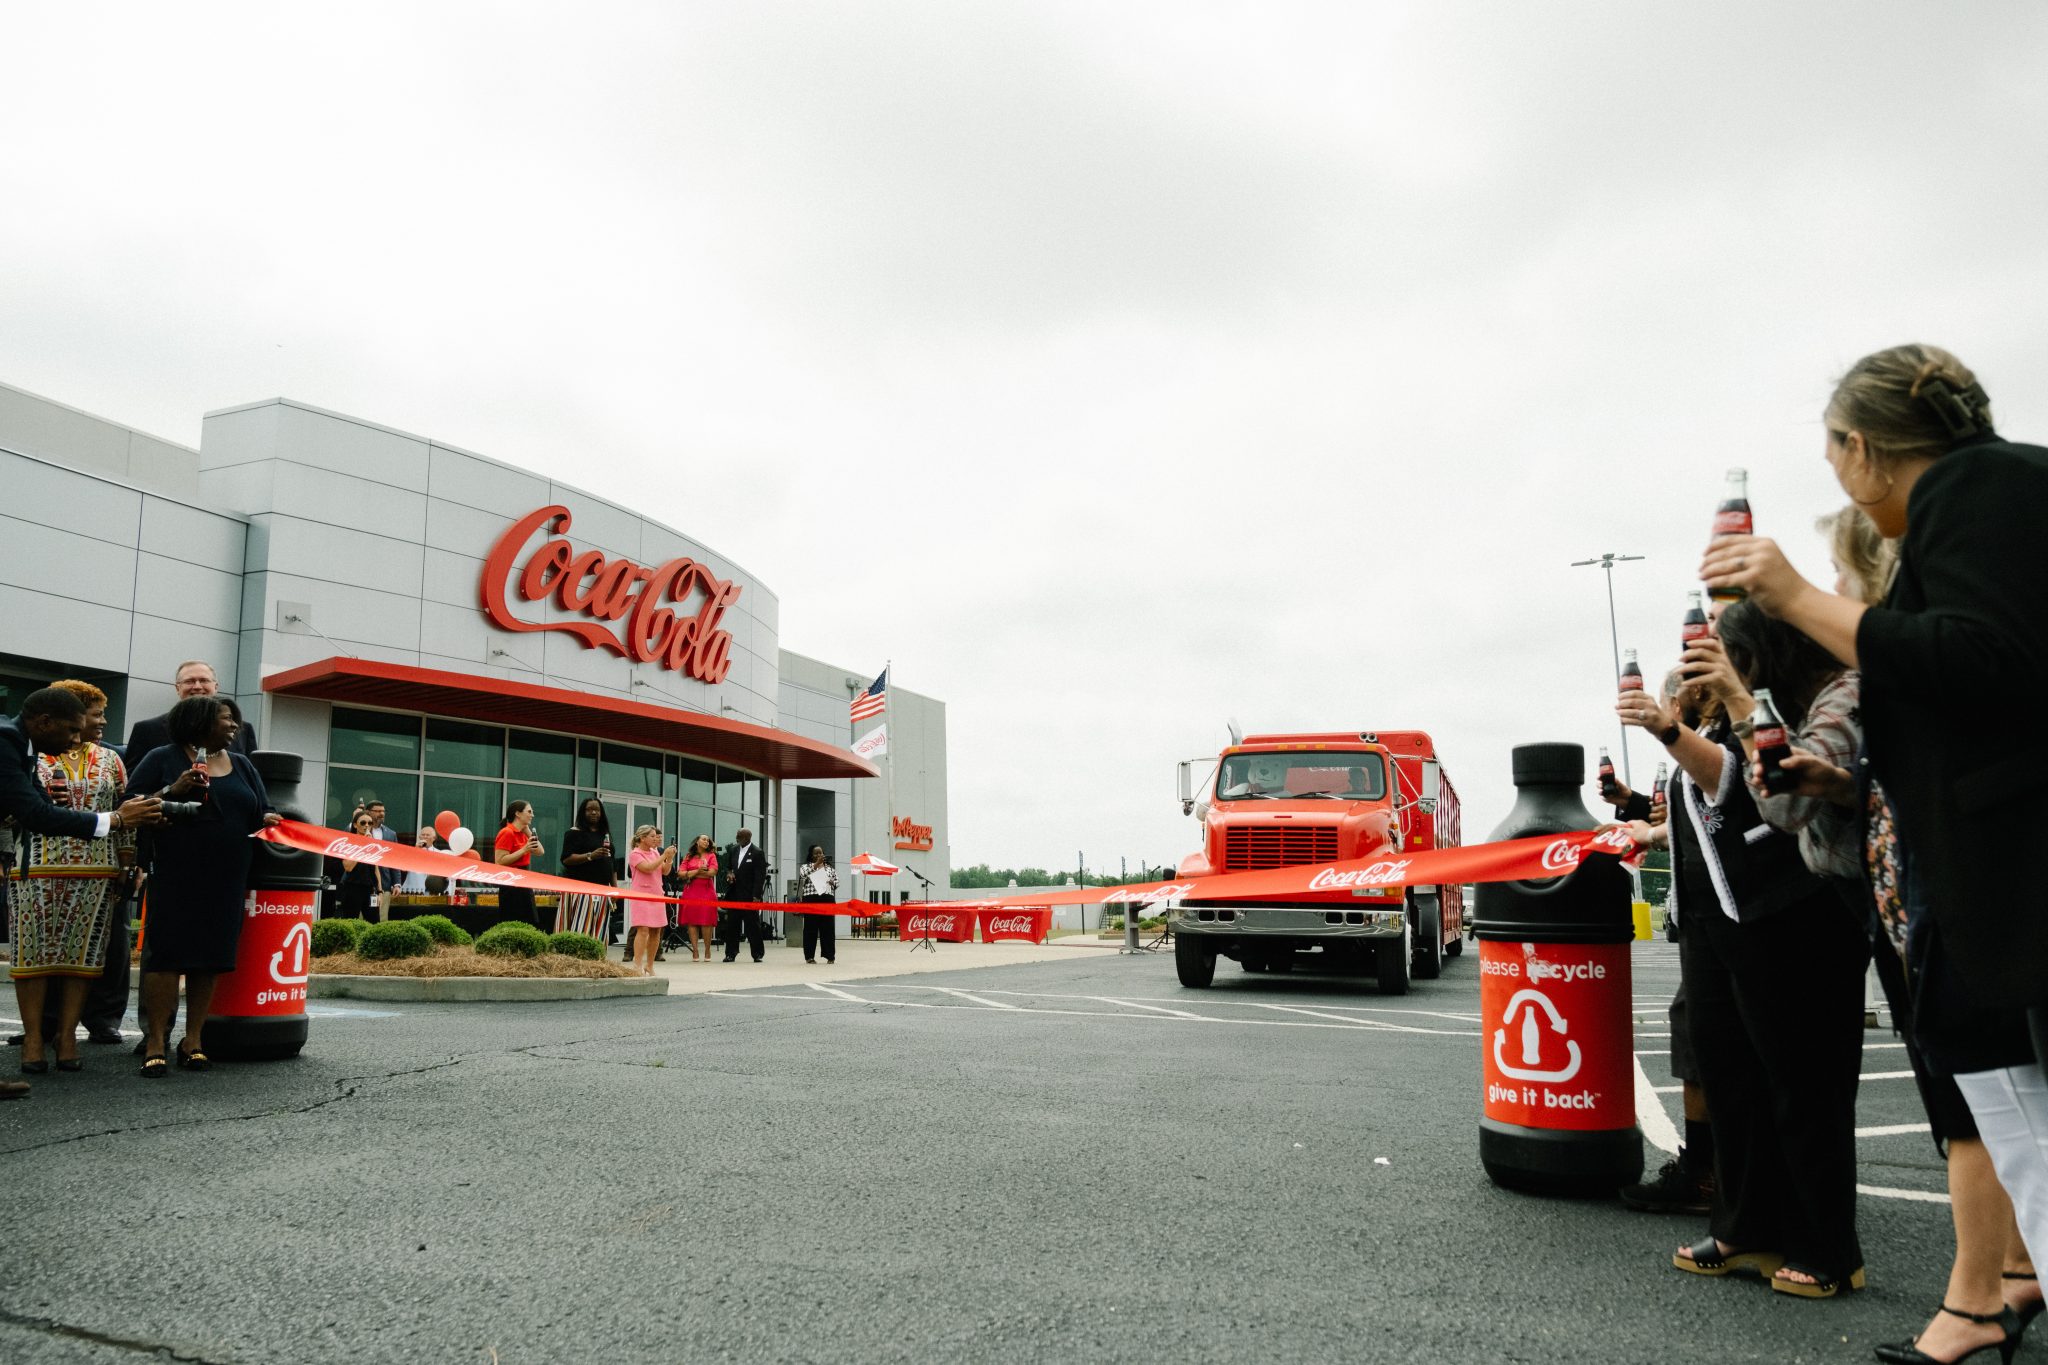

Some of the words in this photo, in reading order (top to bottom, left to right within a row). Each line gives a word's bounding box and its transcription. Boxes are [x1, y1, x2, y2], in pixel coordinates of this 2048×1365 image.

[481, 505, 742, 684] Coca-Cola
[1308, 859, 1413, 890] Coca-Cola
[989, 915, 1034, 933] Coca-Cola
[1527, 960, 1606, 982] ecycle
[257, 989, 287, 1004] give
[291, 987, 299, 1000] it
[1489, 1082, 1517, 1103] give
[1523, 1087, 1537, 1105] it
